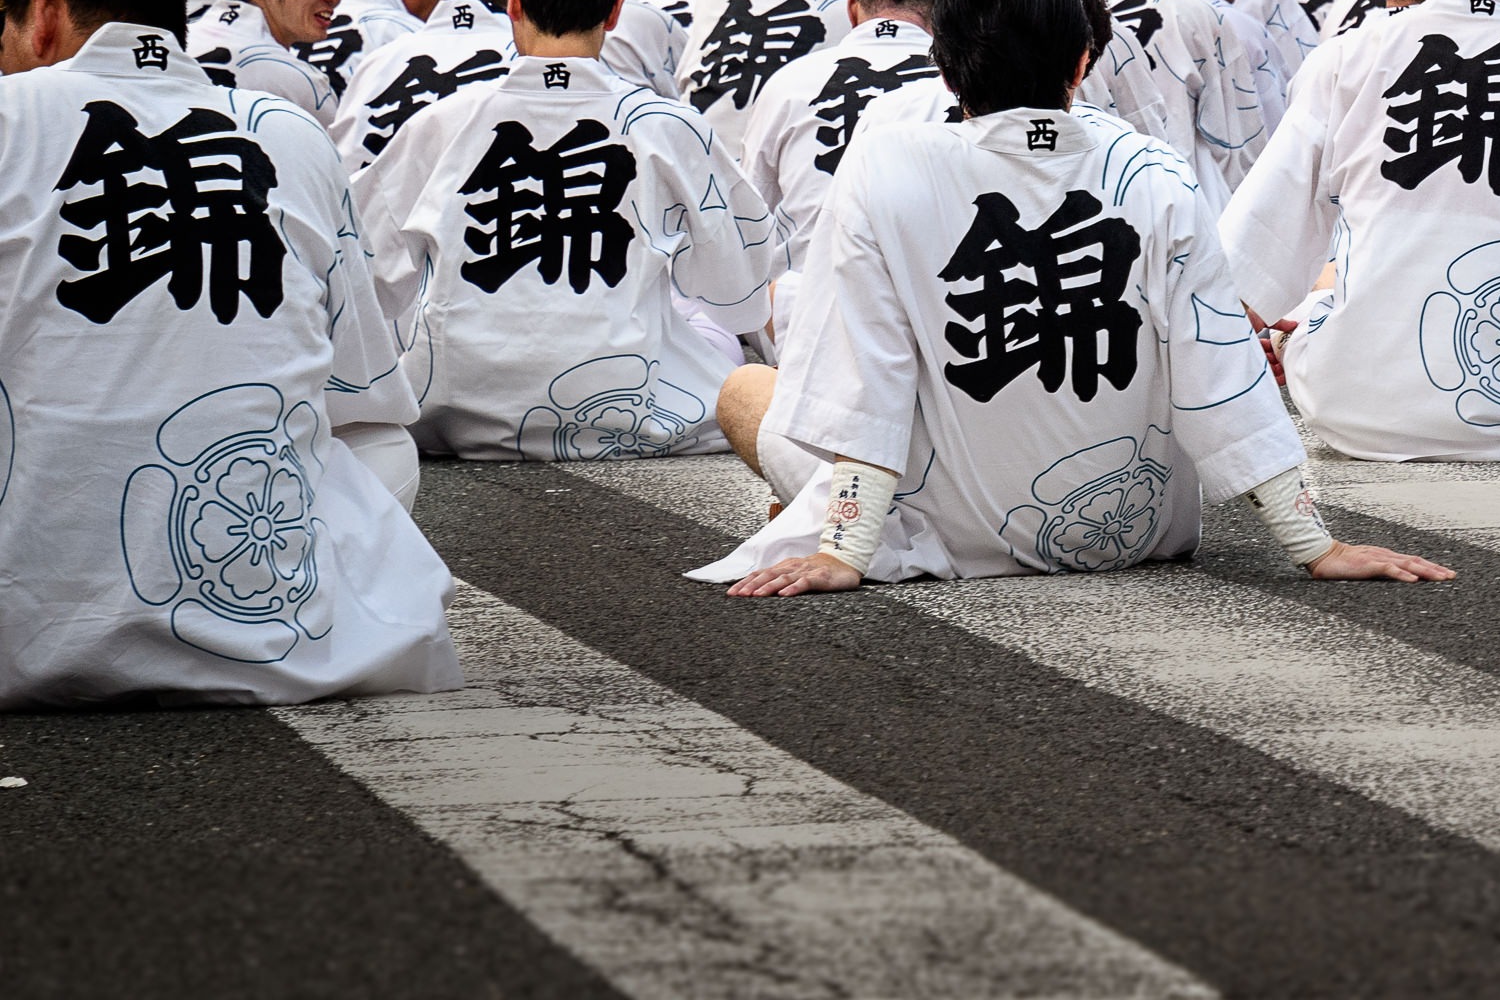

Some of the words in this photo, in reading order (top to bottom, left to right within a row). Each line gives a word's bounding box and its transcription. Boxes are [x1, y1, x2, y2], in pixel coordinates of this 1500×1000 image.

[452, 4, 475, 30] 西
[875, 20, 899, 38] 西
[133, 33, 170, 72] 西
[543, 62, 571, 90] 西
[1025, 118, 1059, 152] 西
[52, 100, 286, 325] 錦
[457, 119, 637, 295] 錦
[937, 190, 1143, 403] 錦
